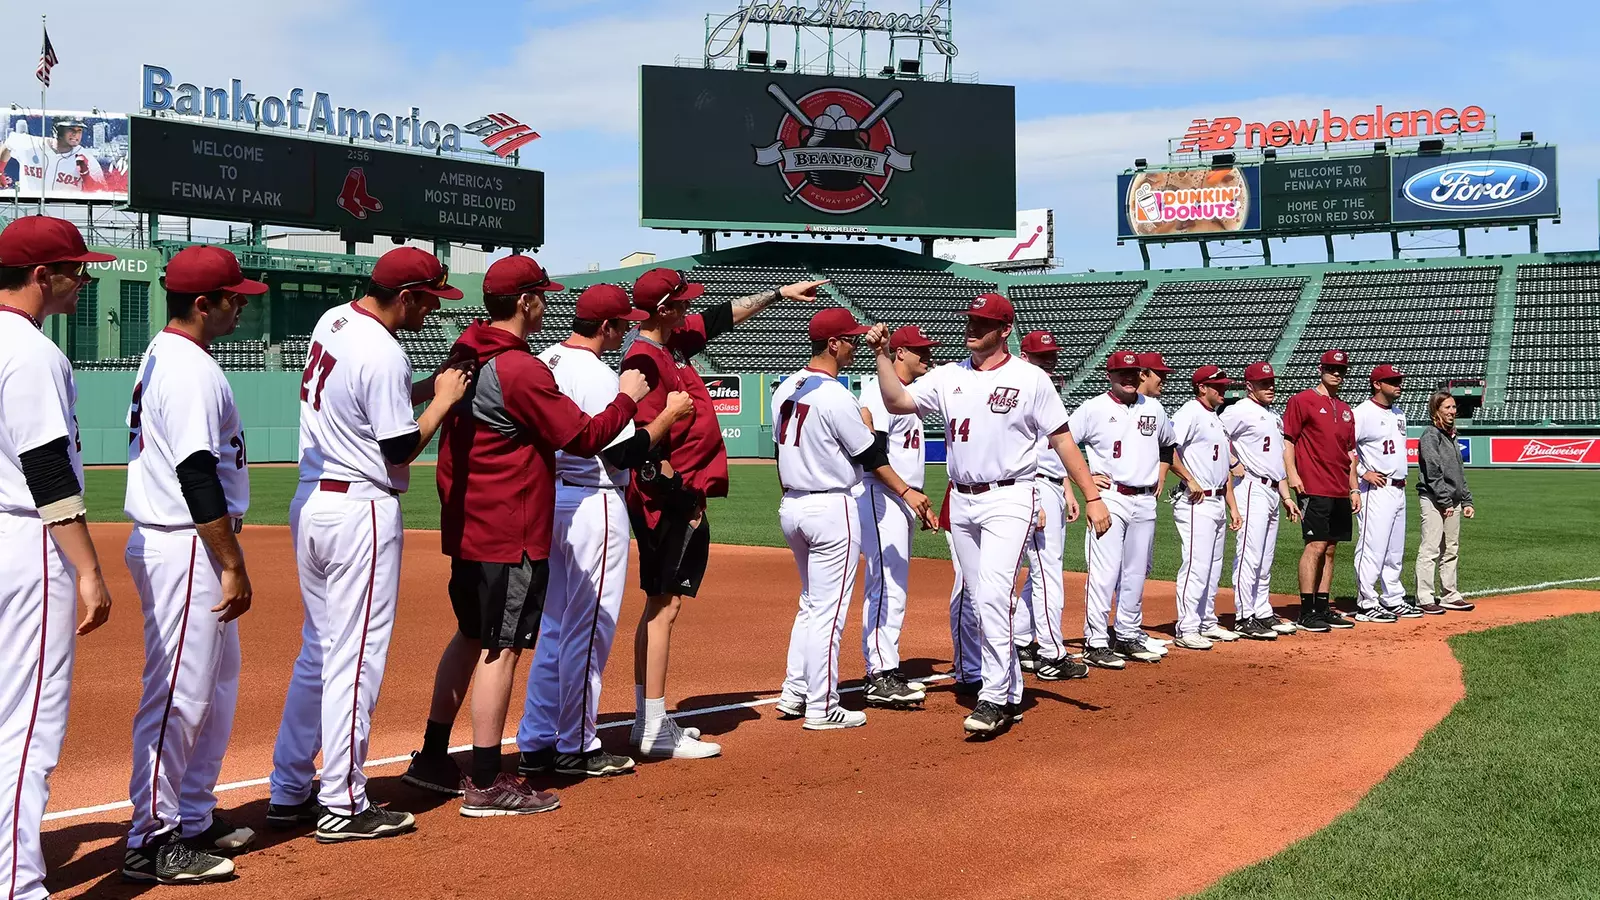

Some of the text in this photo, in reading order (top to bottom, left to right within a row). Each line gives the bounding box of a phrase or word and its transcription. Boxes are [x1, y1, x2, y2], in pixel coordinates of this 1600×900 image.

[1244, 105, 1486, 149] new balance
[192, 139, 264, 162] WELCOME
[347, 149, 370, 162] 2:56
[793, 151, 878, 171] BEANPOT
[23, 164, 43, 179] RED
[56, 172, 81, 187] SOX
[219, 165, 238, 180] TO
[1289, 165, 1361, 178] WELCOME TO
[439, 171, 503, 191] AMERICA'S
[1284, 177, 1367, 191] FENWAY PARK
[1430, 169, 1517, 203] Ford
[171, 181, 282, 207] FENWAY PARK
[424, 189, 516, 212] MOST BELOVED
[810, 191, 866, 204] FENWAY PARK
[1163, 186, 1240, 205] DUNKIN'
[1163, 203, 1236, 221] DONUTS
[1287, 198, 1365, 212] HOME OF THE
[439, 210, 503, 229] BALLPARK
[1278, 210, 1375, 224] BOSTON RED SOX
[300, 340, 338, 412] 27
[706, 387, 739, 398] elite
[714, 403, 739, 411] oGlass
[721, 428, 741, 438] 420
[949, 417, 971, 442] 44
[903, 428, 920, 449] 16
[1262, 435, 1271, 452] 2
[1382, 439, 1396, 455] 12
[230, 431, 247, 470] 2
[1112, 440, 1122, 459] 9
[1212, 444, 1219, 461] 3
[1523, 444, 1586, 456] Budweiser
